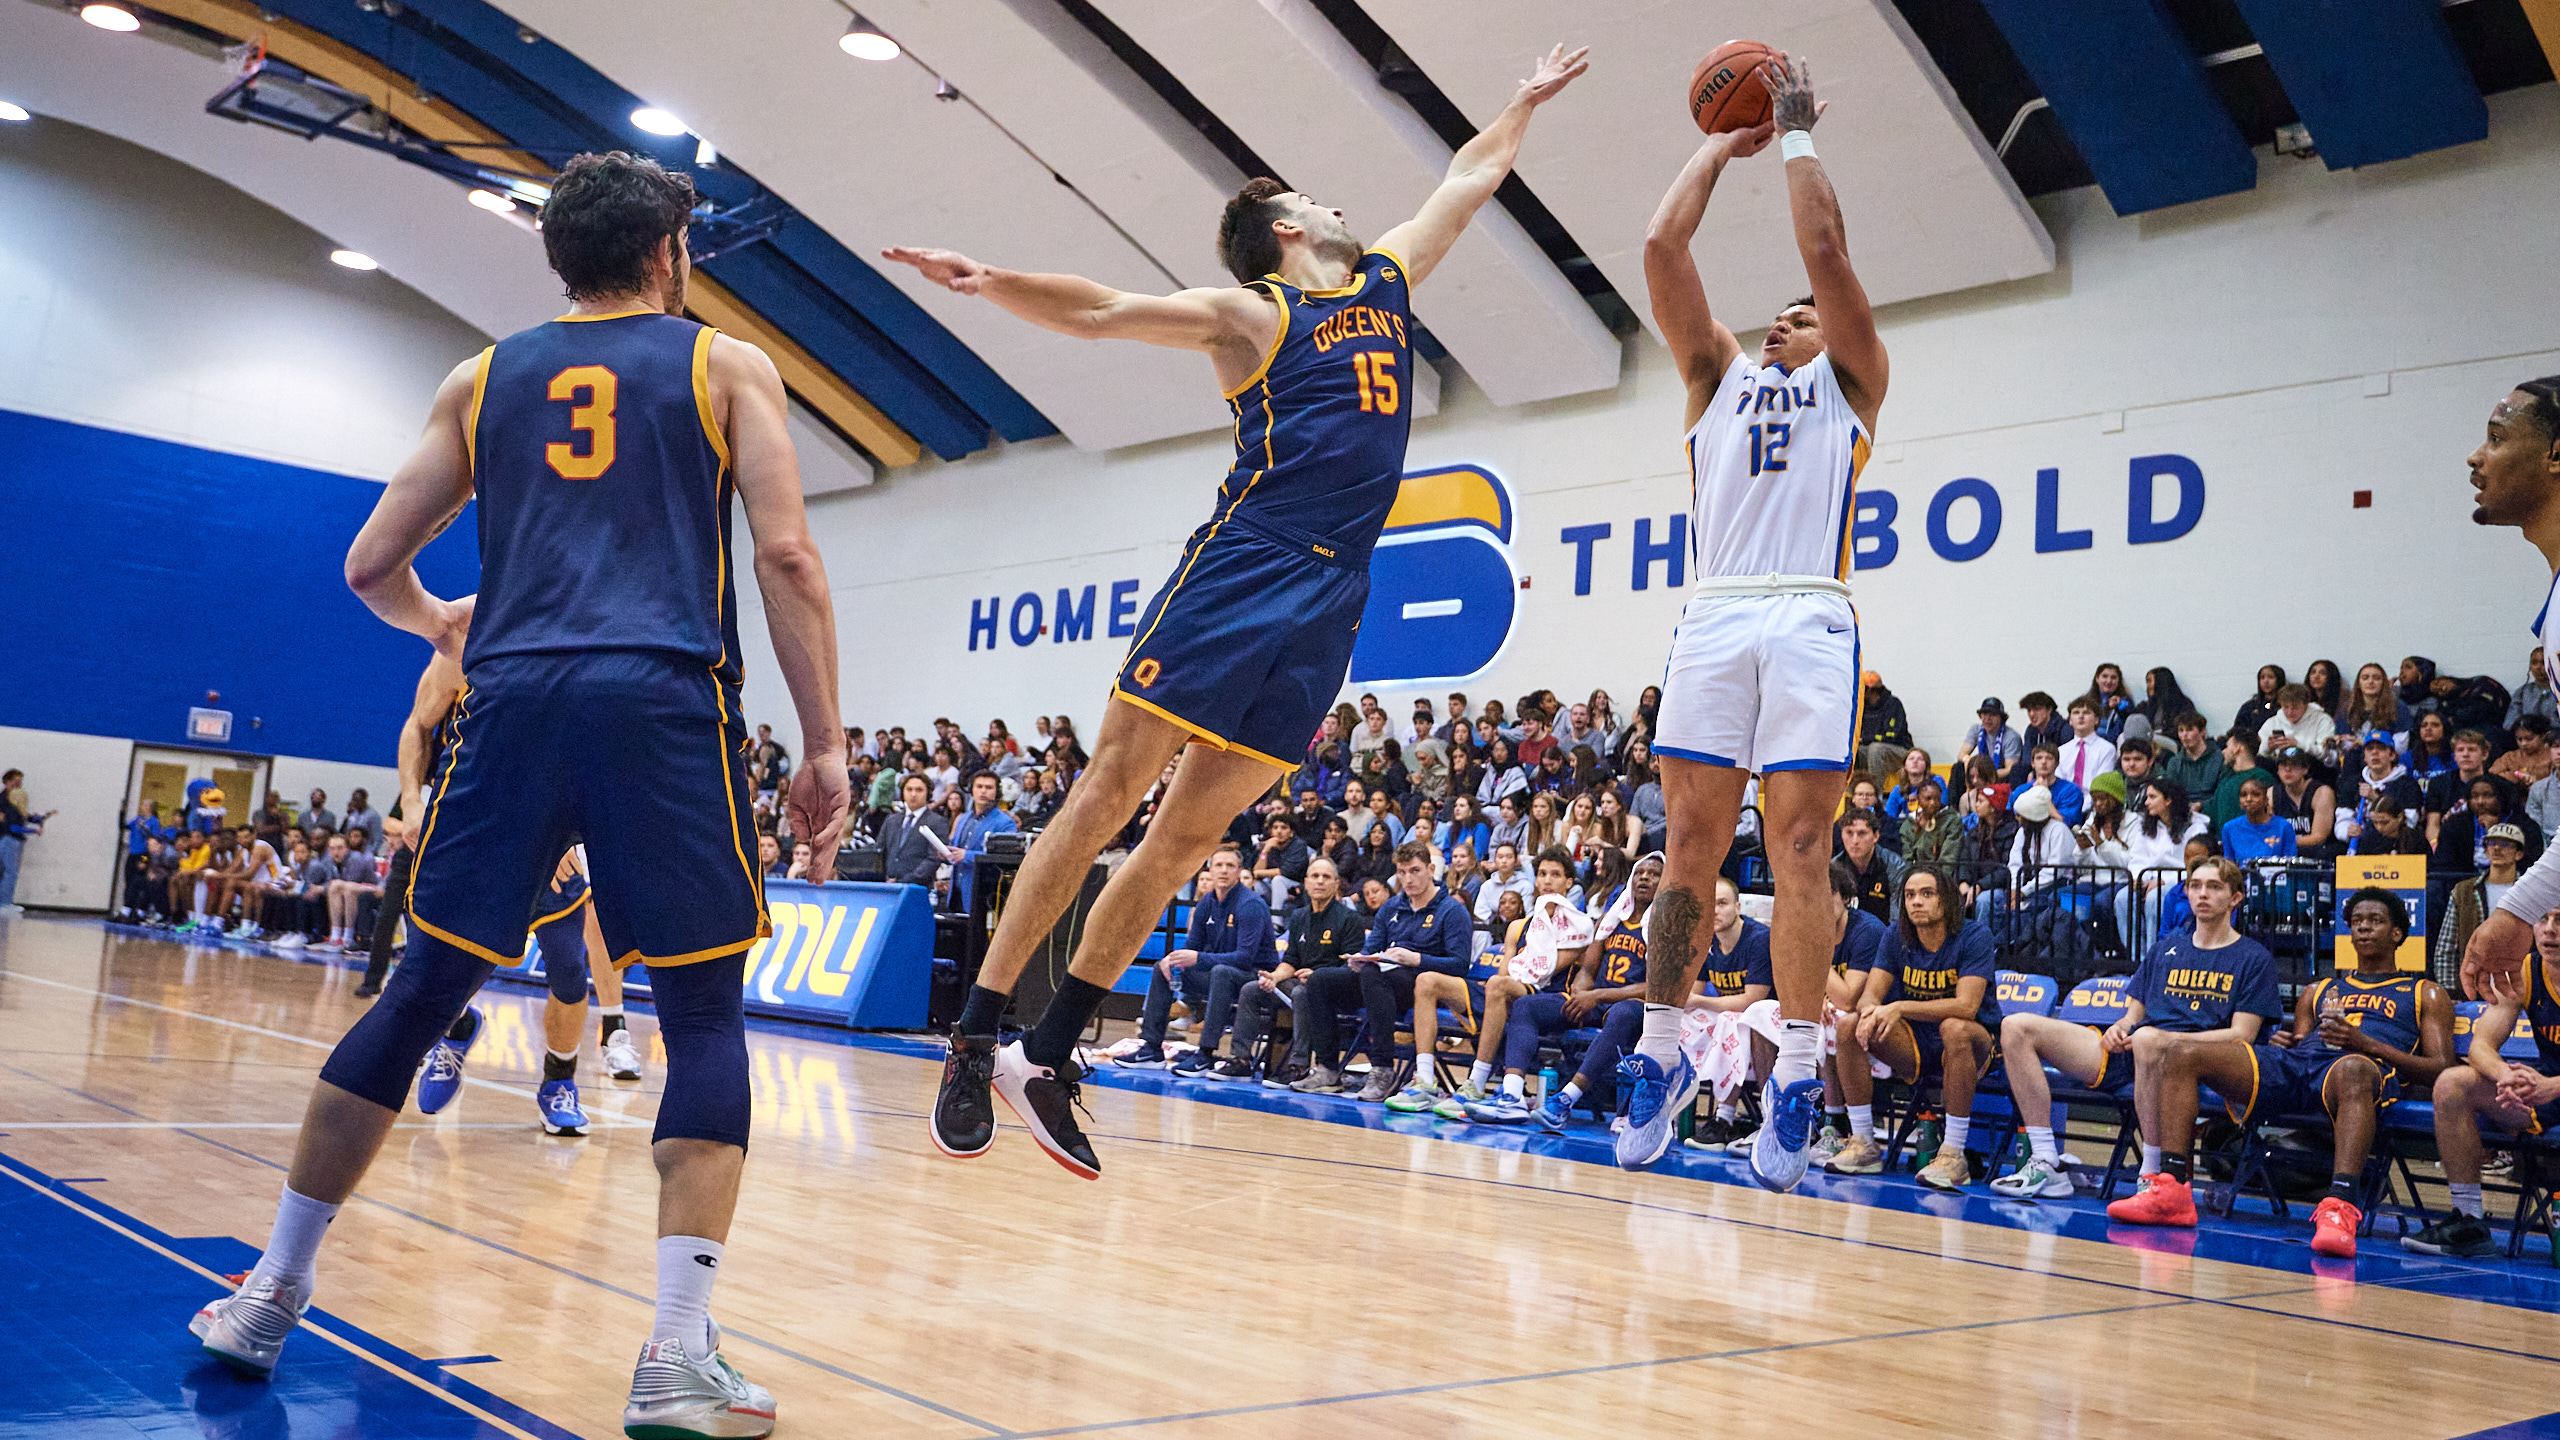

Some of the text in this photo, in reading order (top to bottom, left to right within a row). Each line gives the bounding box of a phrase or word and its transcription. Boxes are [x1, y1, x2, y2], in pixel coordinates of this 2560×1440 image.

[1313, 306, 1407, 353] QUEEN'S
[1352, 350, 1400, 416] 15
[545, 364, 618, 480] 3
[1748, 422, 1792, 478] 12
[968, 453, 2206, 651] HOME TH BOLD
[1312, 543, 1336, 559] GAELS
[2362, 871, 2400, 880] BOLD
[744, 900, 878, 997] MU
[1606, 953, 1632, 984] 12
[2001, 973, 2027, 983] TMU
[2166, 968, 2235, 992] QUEEN'S
[1996, 984, 2045, 1003] OLD
[2097, 978, 2125, 988] TMU
[2070, 989, 2132, 1009] BOL
